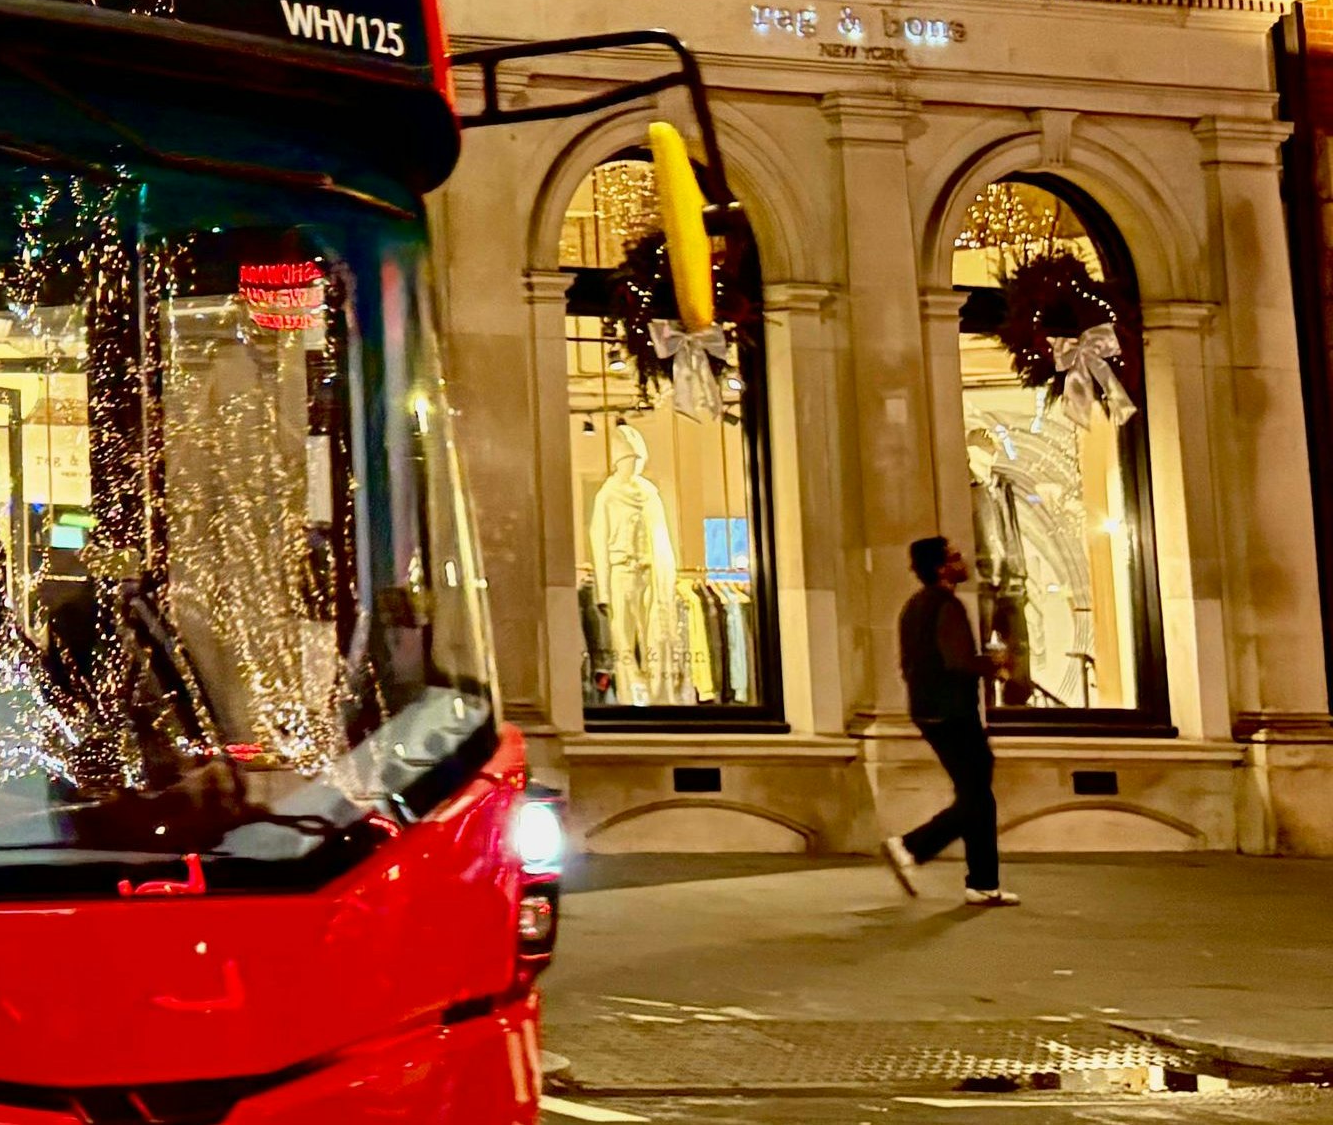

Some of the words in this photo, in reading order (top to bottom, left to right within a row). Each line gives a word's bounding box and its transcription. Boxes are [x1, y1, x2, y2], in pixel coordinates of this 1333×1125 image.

[837, 5, 864, 36] &
[880, 8, 968, 44] bone
[818, 42, 858, 59] NEW
[863, 46, 909, 63] YORK
